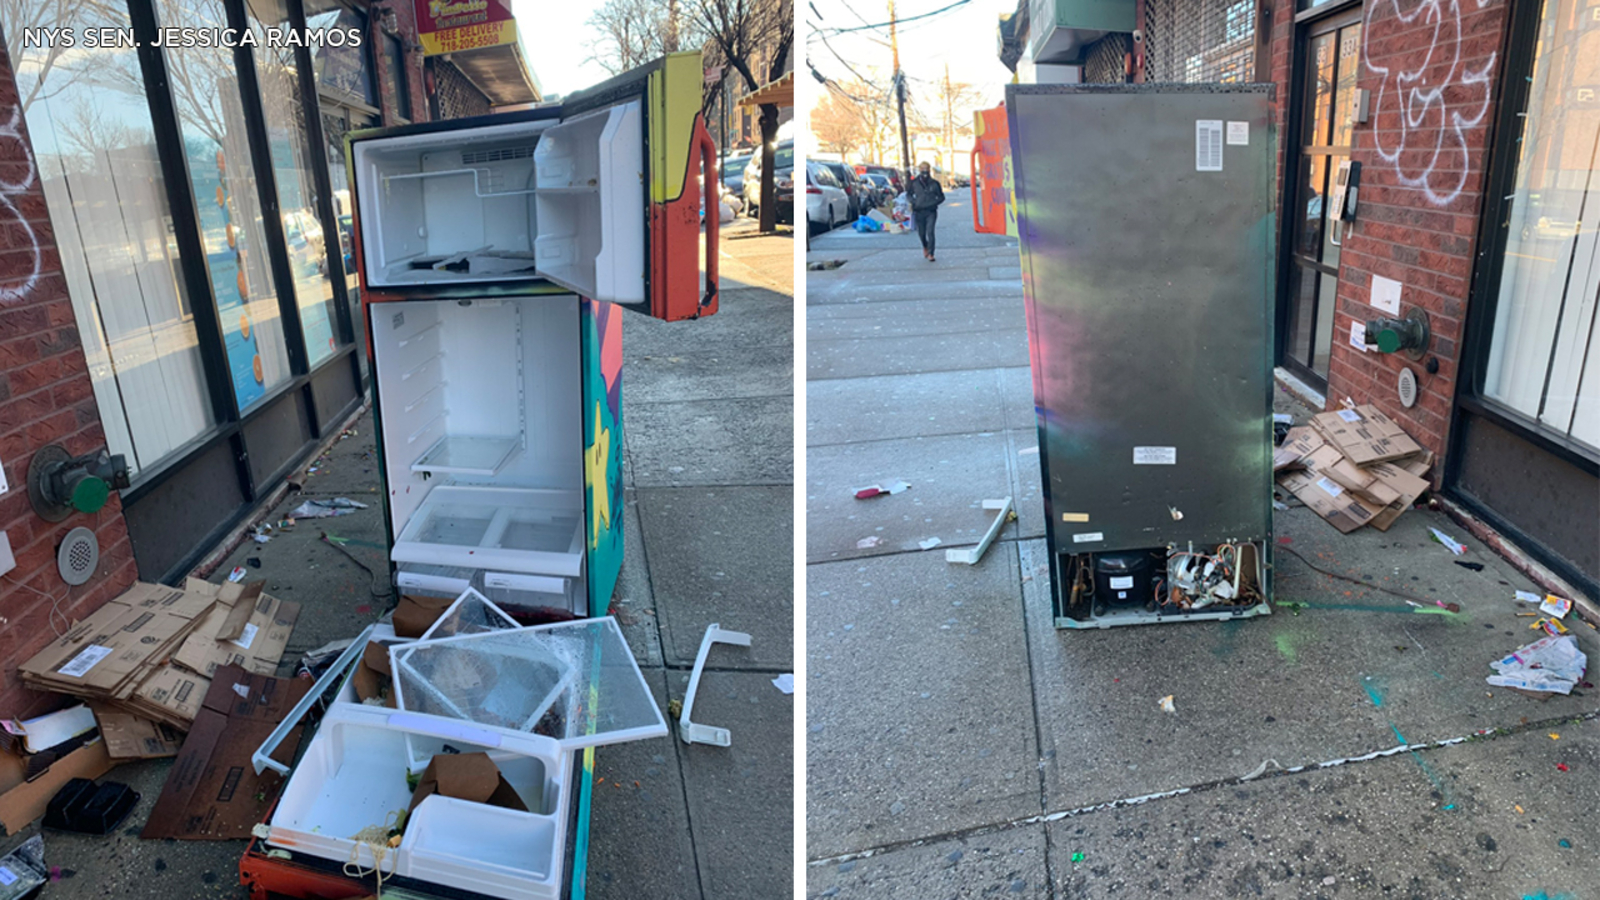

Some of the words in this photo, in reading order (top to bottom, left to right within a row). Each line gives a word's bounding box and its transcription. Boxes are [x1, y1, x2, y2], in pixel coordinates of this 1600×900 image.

[434, 28, 457, 43] FREE
[459, 21, 504, 38] DELIVERY
[440, 33, 499, 52] 718-205-5508
